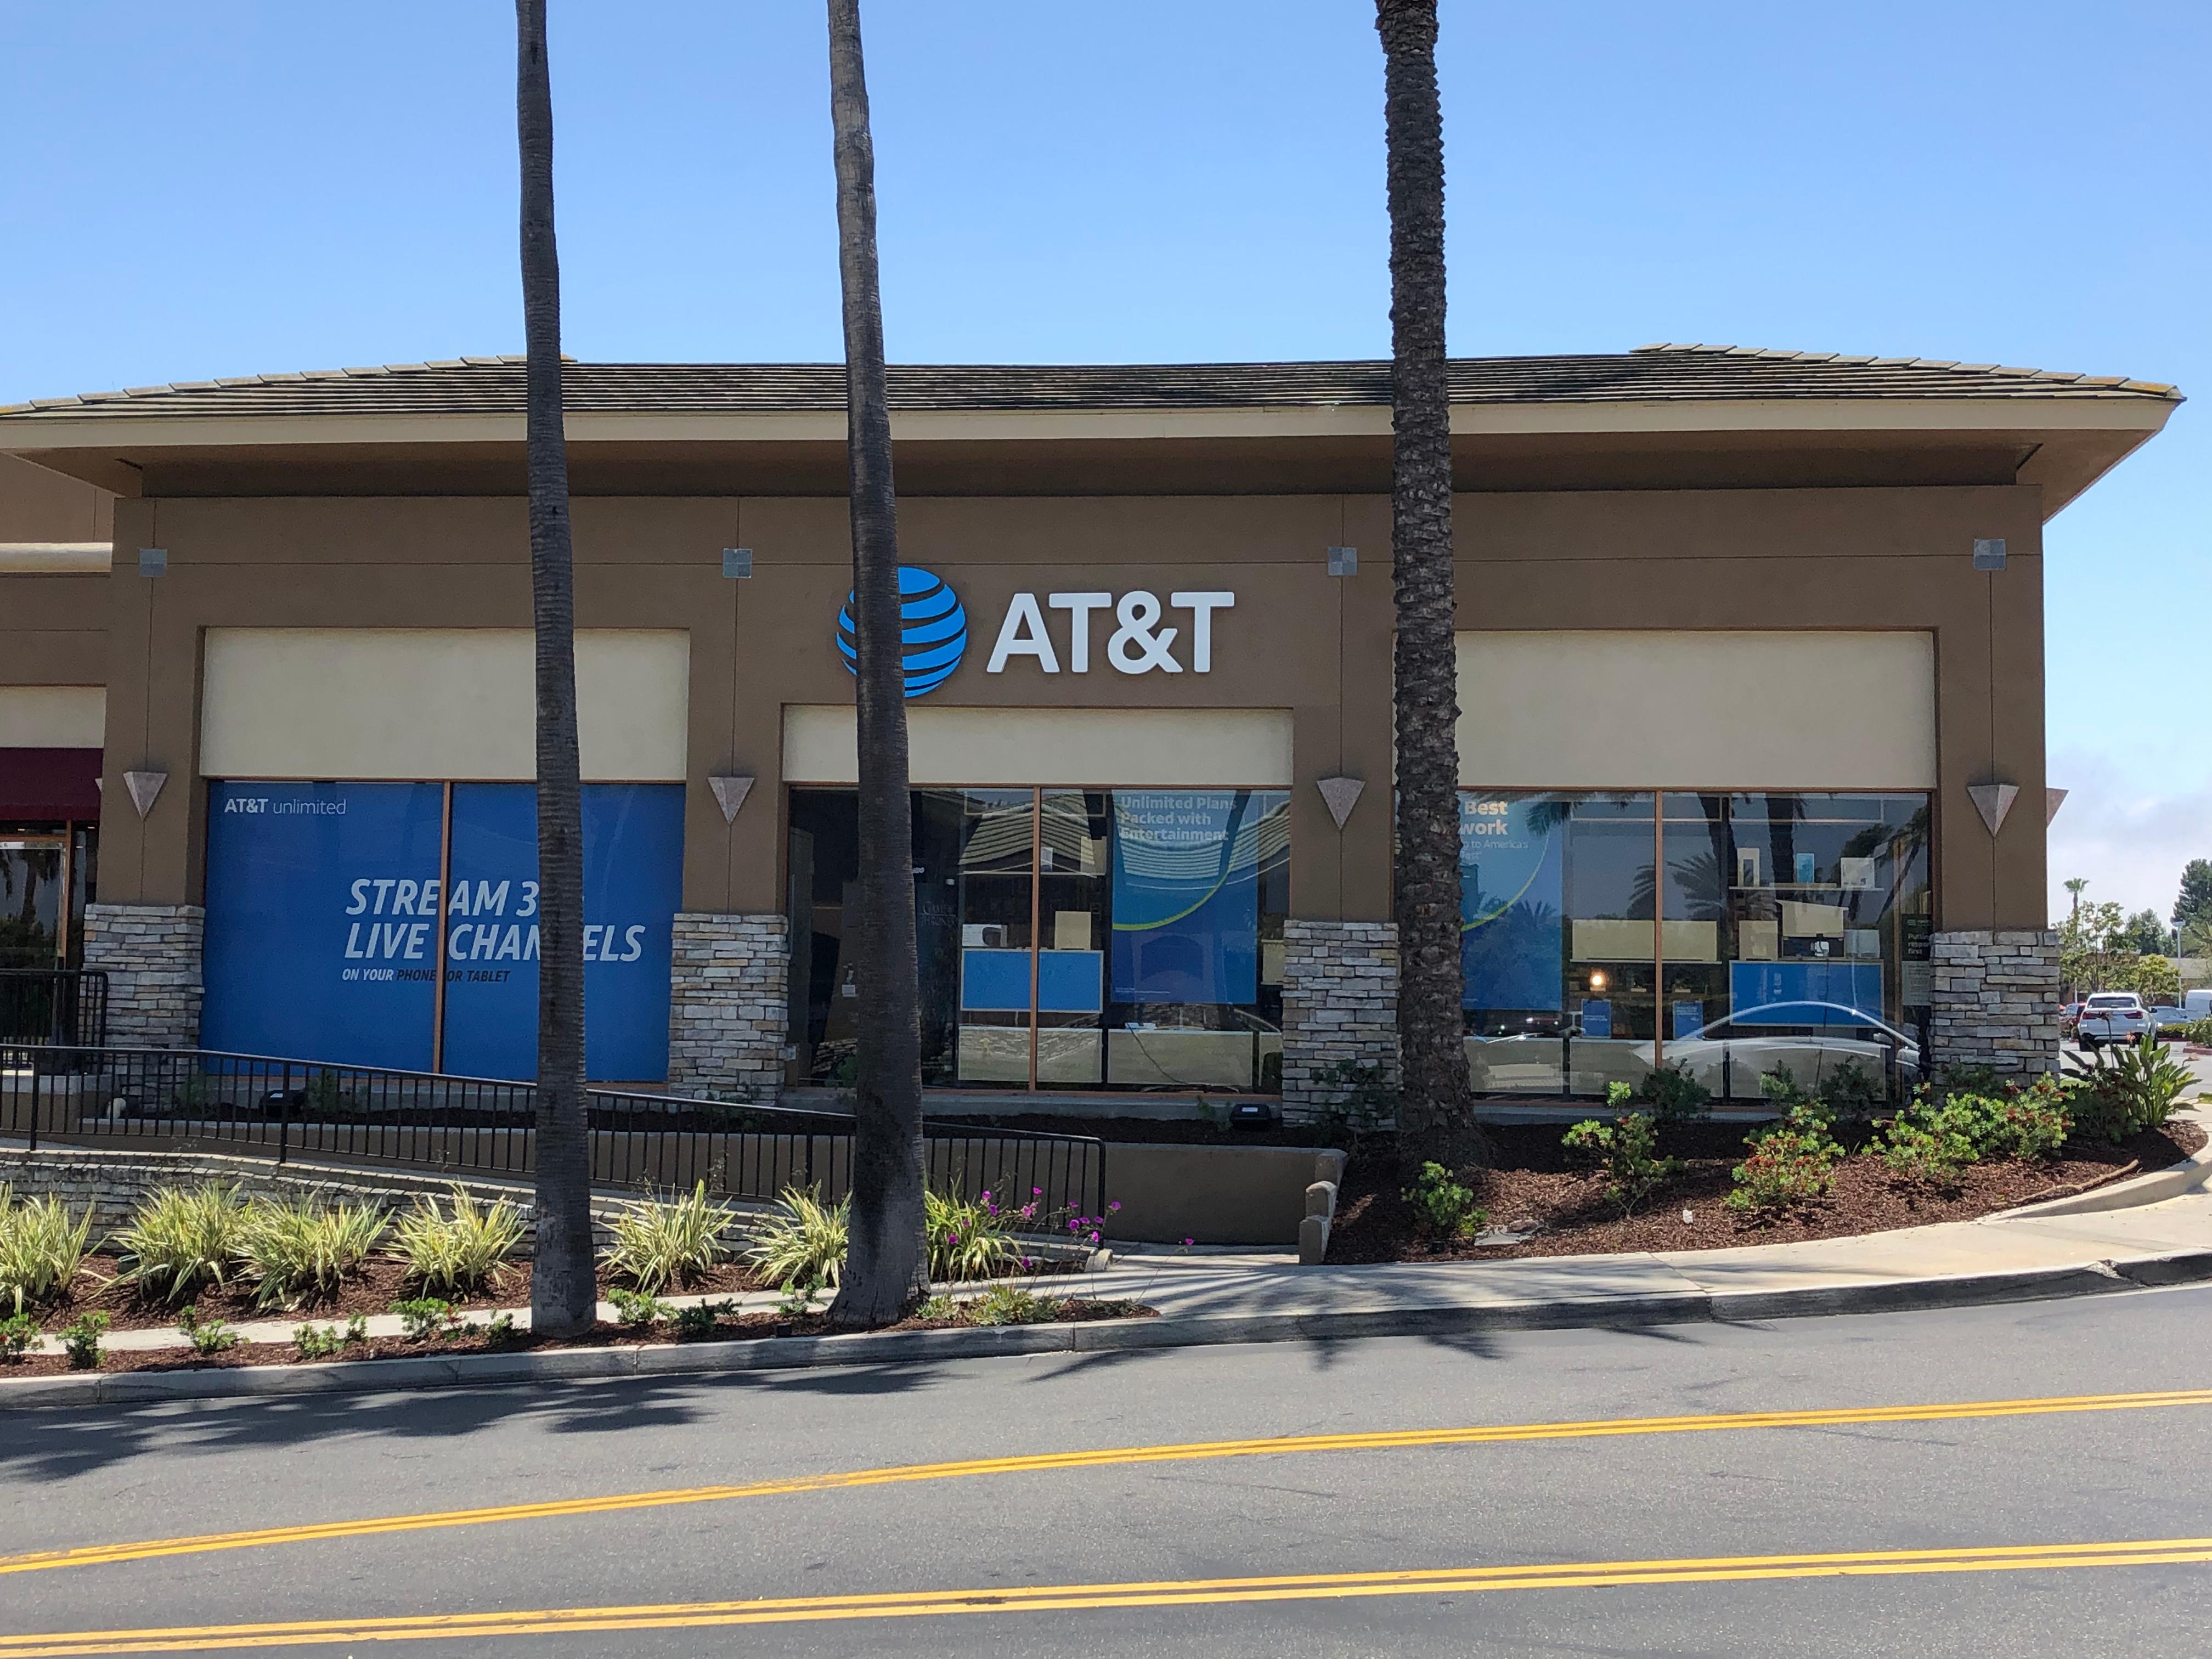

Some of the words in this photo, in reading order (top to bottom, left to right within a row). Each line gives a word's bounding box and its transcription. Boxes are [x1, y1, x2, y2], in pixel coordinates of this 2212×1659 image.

[987, 591, 1234, 674] AT&T
[224, 798, 269, 814] AT&T
[273, 798, 347, 814] unlimited
[1121, 795, 1193, 809] Unlimited
[1197, 796, 1237, 810] Plans
[1464, 801, 1509, 815] Best
[1121, 811, 1175, 825] Packed
[1178, 812, 1211, 825] with
[1120, 827, 1229, 841] Entertainment
[1458, 819, 1509, 835] work
[1471, 840, 1481, 849] to
[345, 878, 511, 916] STREAM
[345, 922, 430, 960] LIVE
[449, 923, 646, 962] CHANELS
[342, 968, 359, 981] ON
[363, 968, 394, 981] YOUR
[396, 969, 437, 981] PHONE
[447, 970, 462, 982] OR
[467, 970, 511, 983] TABLET
